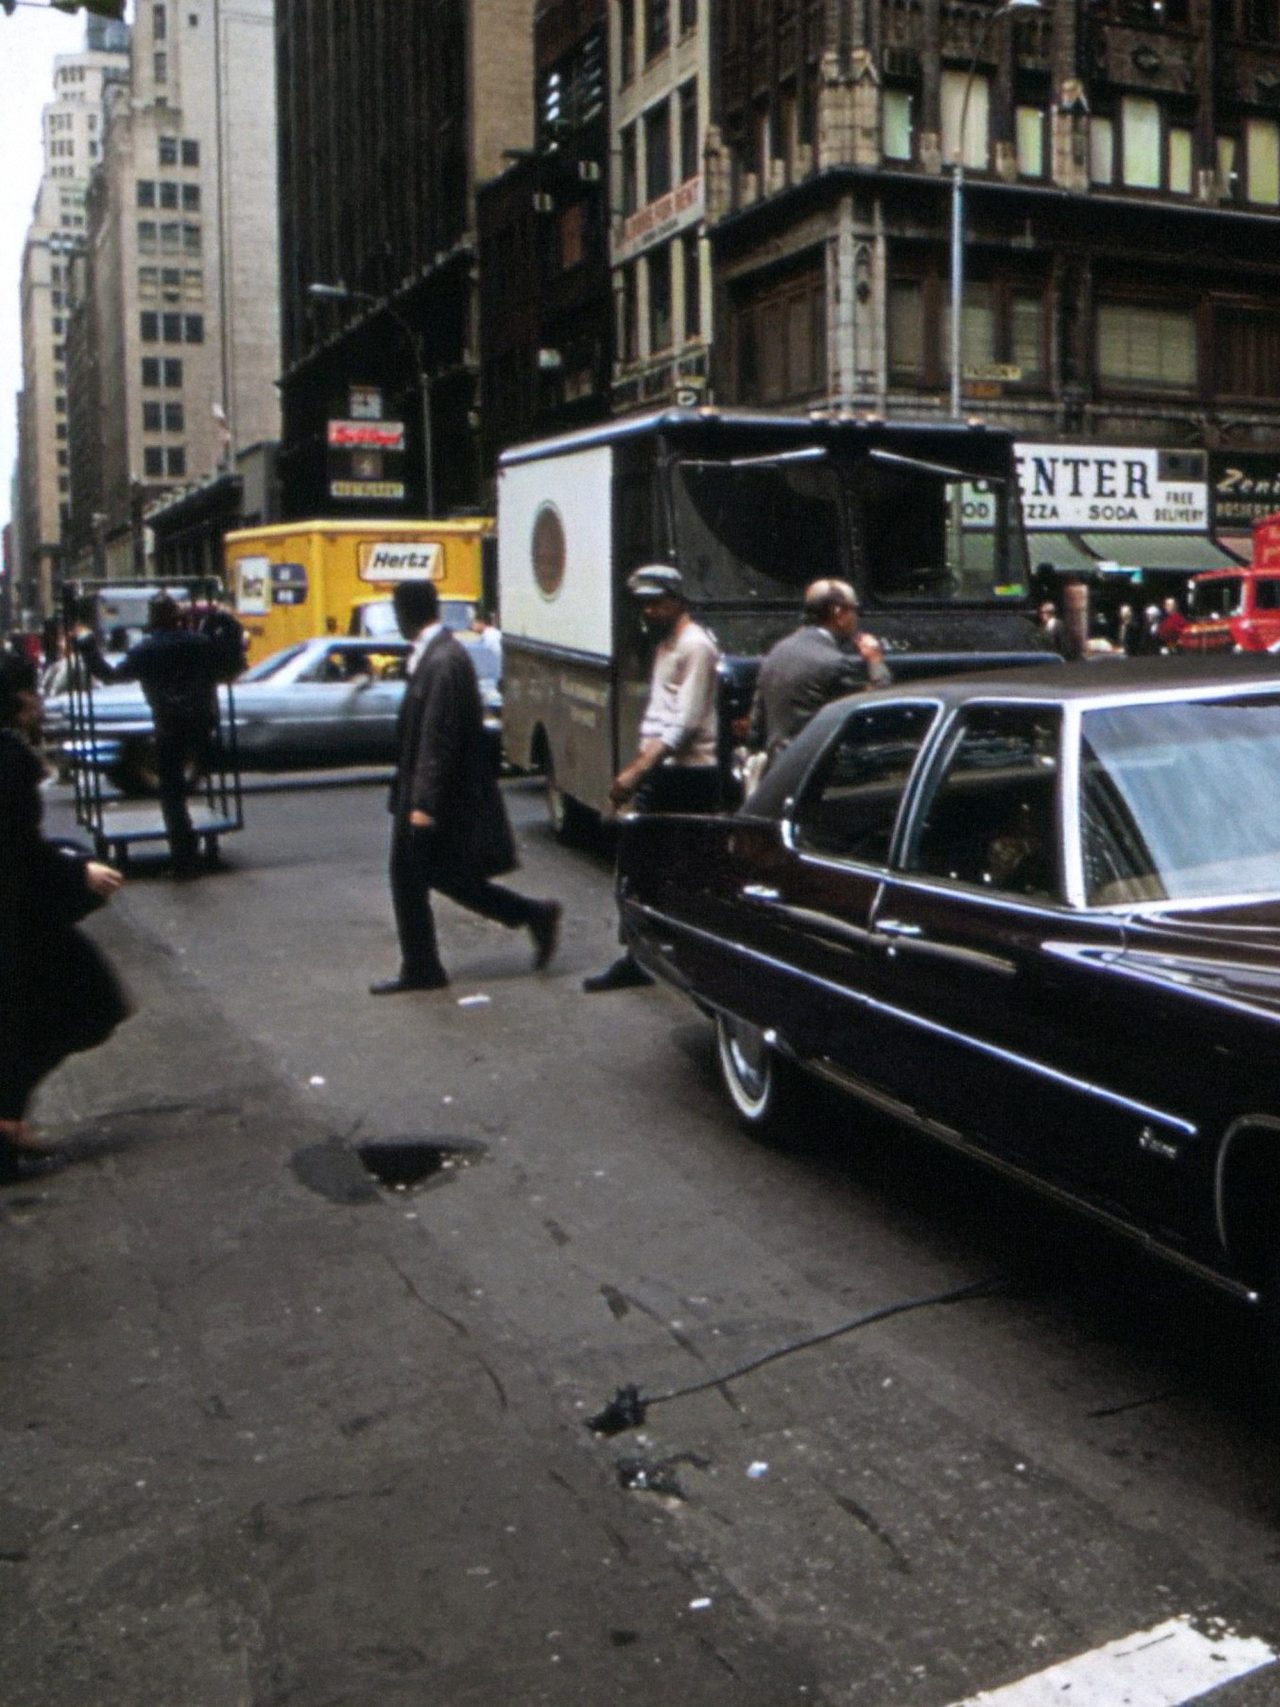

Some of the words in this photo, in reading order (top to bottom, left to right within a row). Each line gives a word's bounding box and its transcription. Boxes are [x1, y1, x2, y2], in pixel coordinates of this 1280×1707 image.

[1166, 491, 1194, 504] FREE
[1089, 506, 1138, 520] SODA
[1155, 509, 1203, 522] DELIVERY
[375, 551, 430, 569] Hertz
